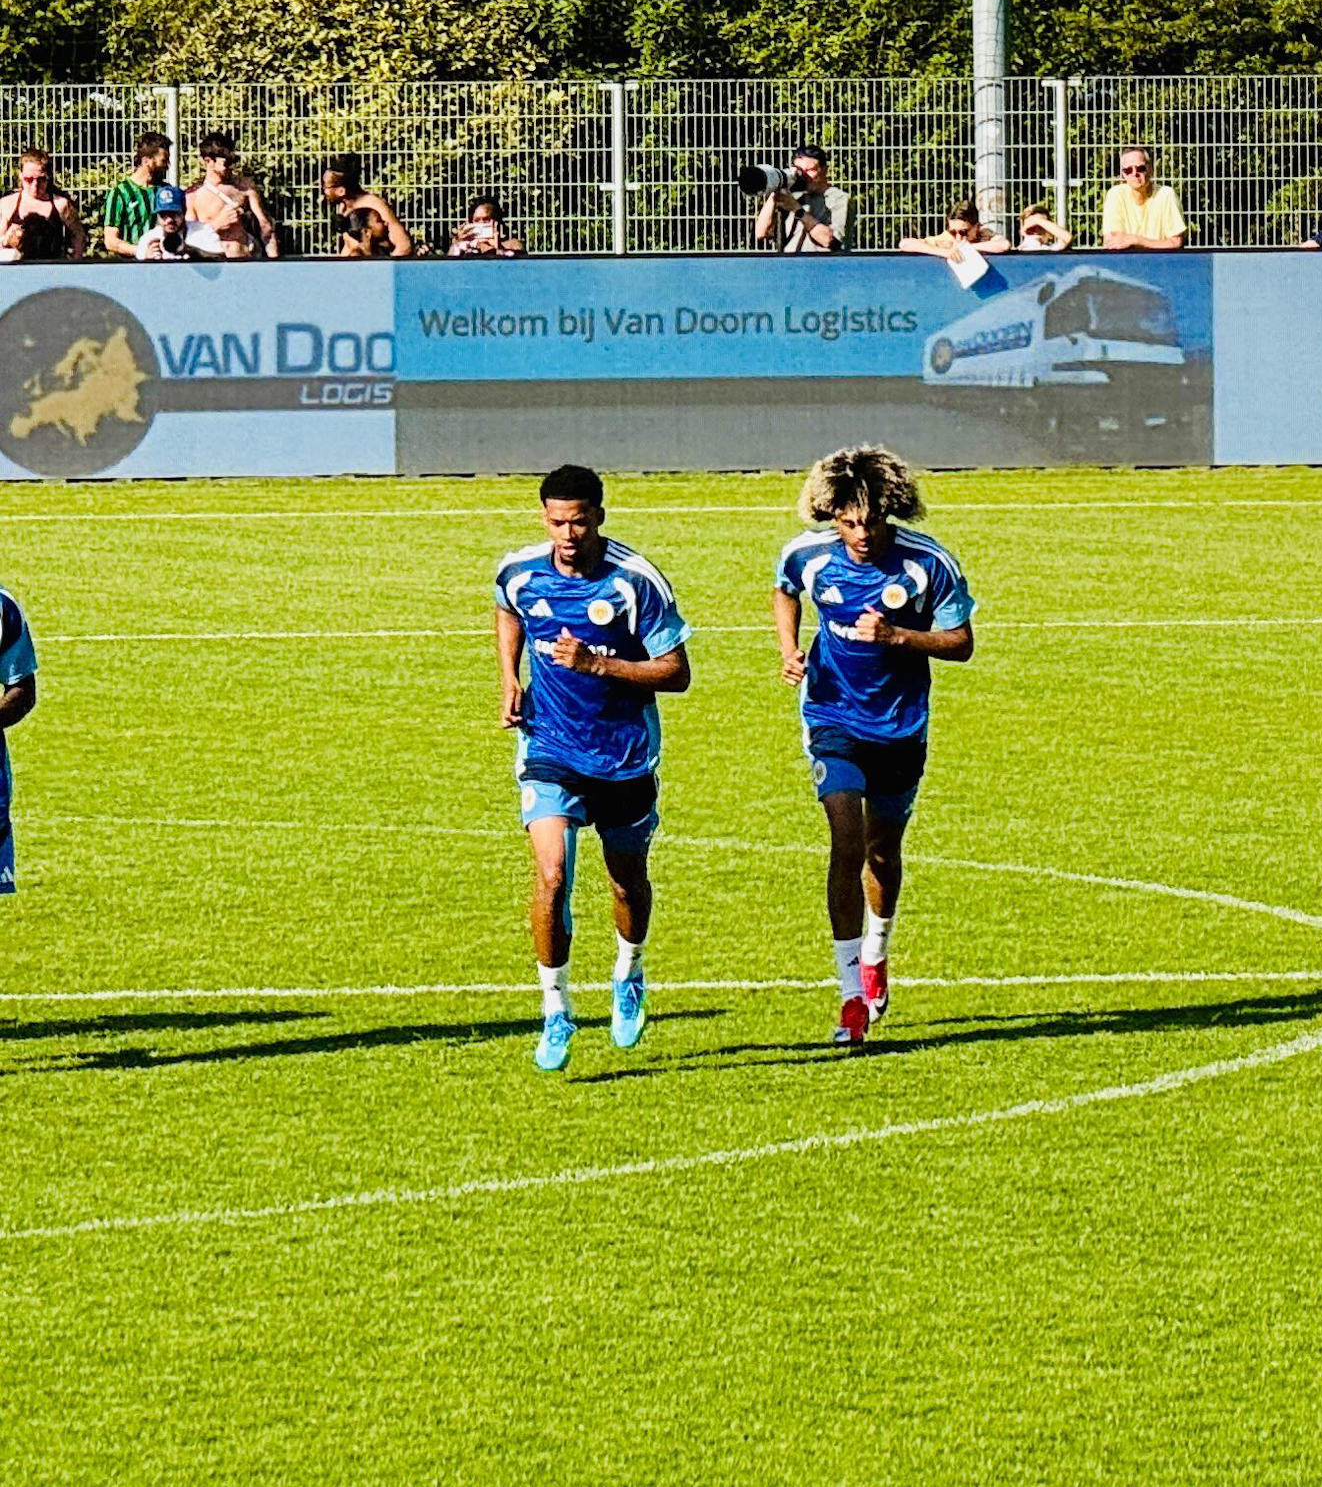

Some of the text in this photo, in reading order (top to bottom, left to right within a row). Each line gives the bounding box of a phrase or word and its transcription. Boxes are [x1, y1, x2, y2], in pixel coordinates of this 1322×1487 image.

[418, 309, 549, 336] Welkom
[559, 307, 594, 343] bij
[605, 310, 664, 335] Van
[675, 309, 779, 334] Doorn
[785, 304, 918, 340] Logistics
[157, 332, 259, 376] VAN
[300, 382, 394, 406] LOGIS
